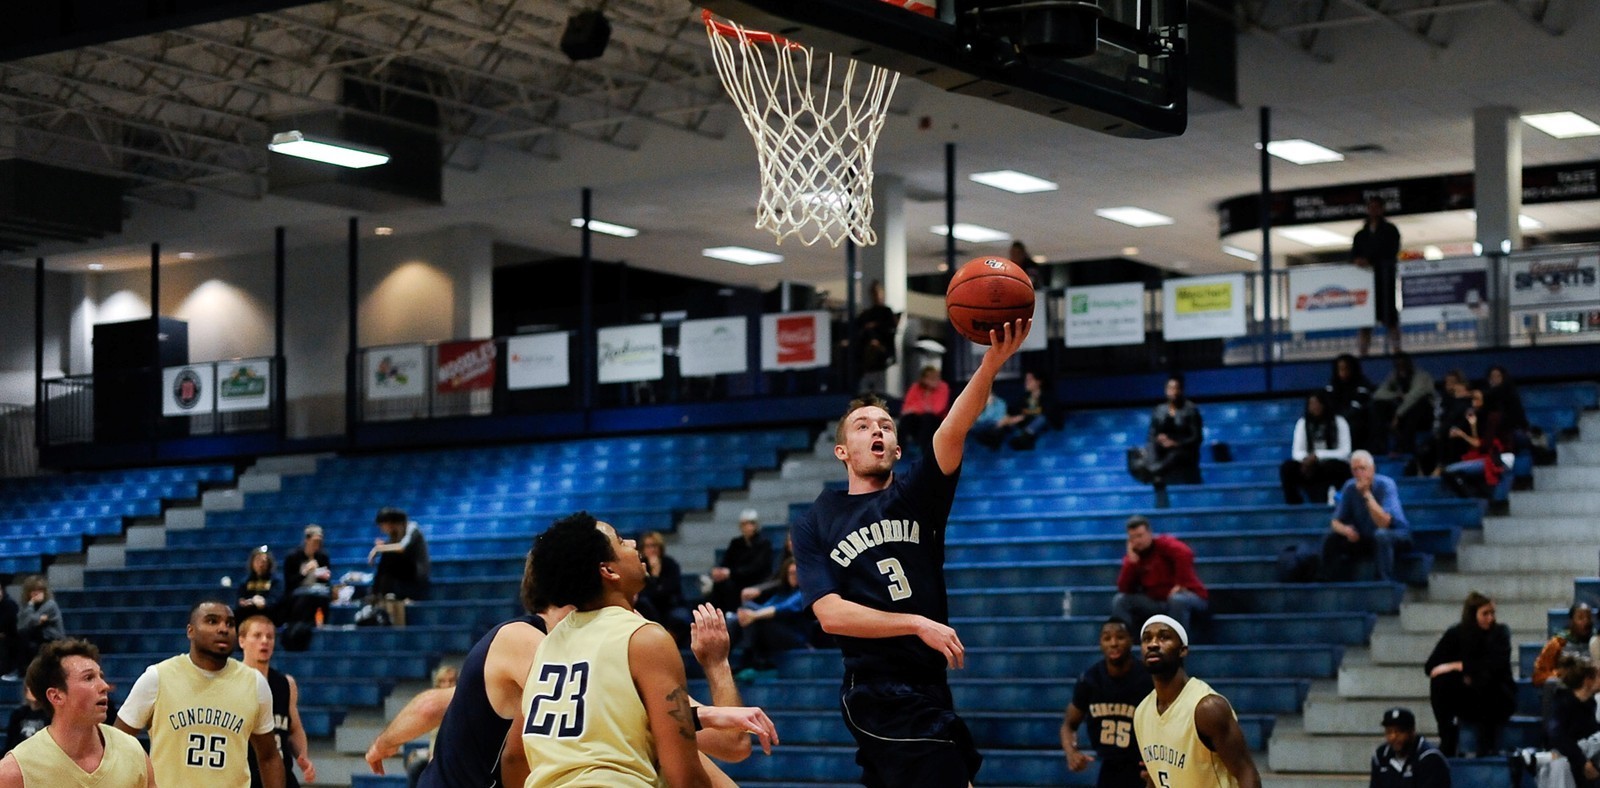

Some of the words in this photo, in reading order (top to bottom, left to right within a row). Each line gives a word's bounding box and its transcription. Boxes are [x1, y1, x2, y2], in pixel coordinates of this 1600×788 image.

[830, 519, 920, 568] CONCORDIA
[876, 557, 912, 602] 3
[523, 661, 590, 738] 23
[169, 708, 244, 734] CONCORDIA
[1100, 719, 1131, 748] 25
[186, 733, 227, 769] 25
